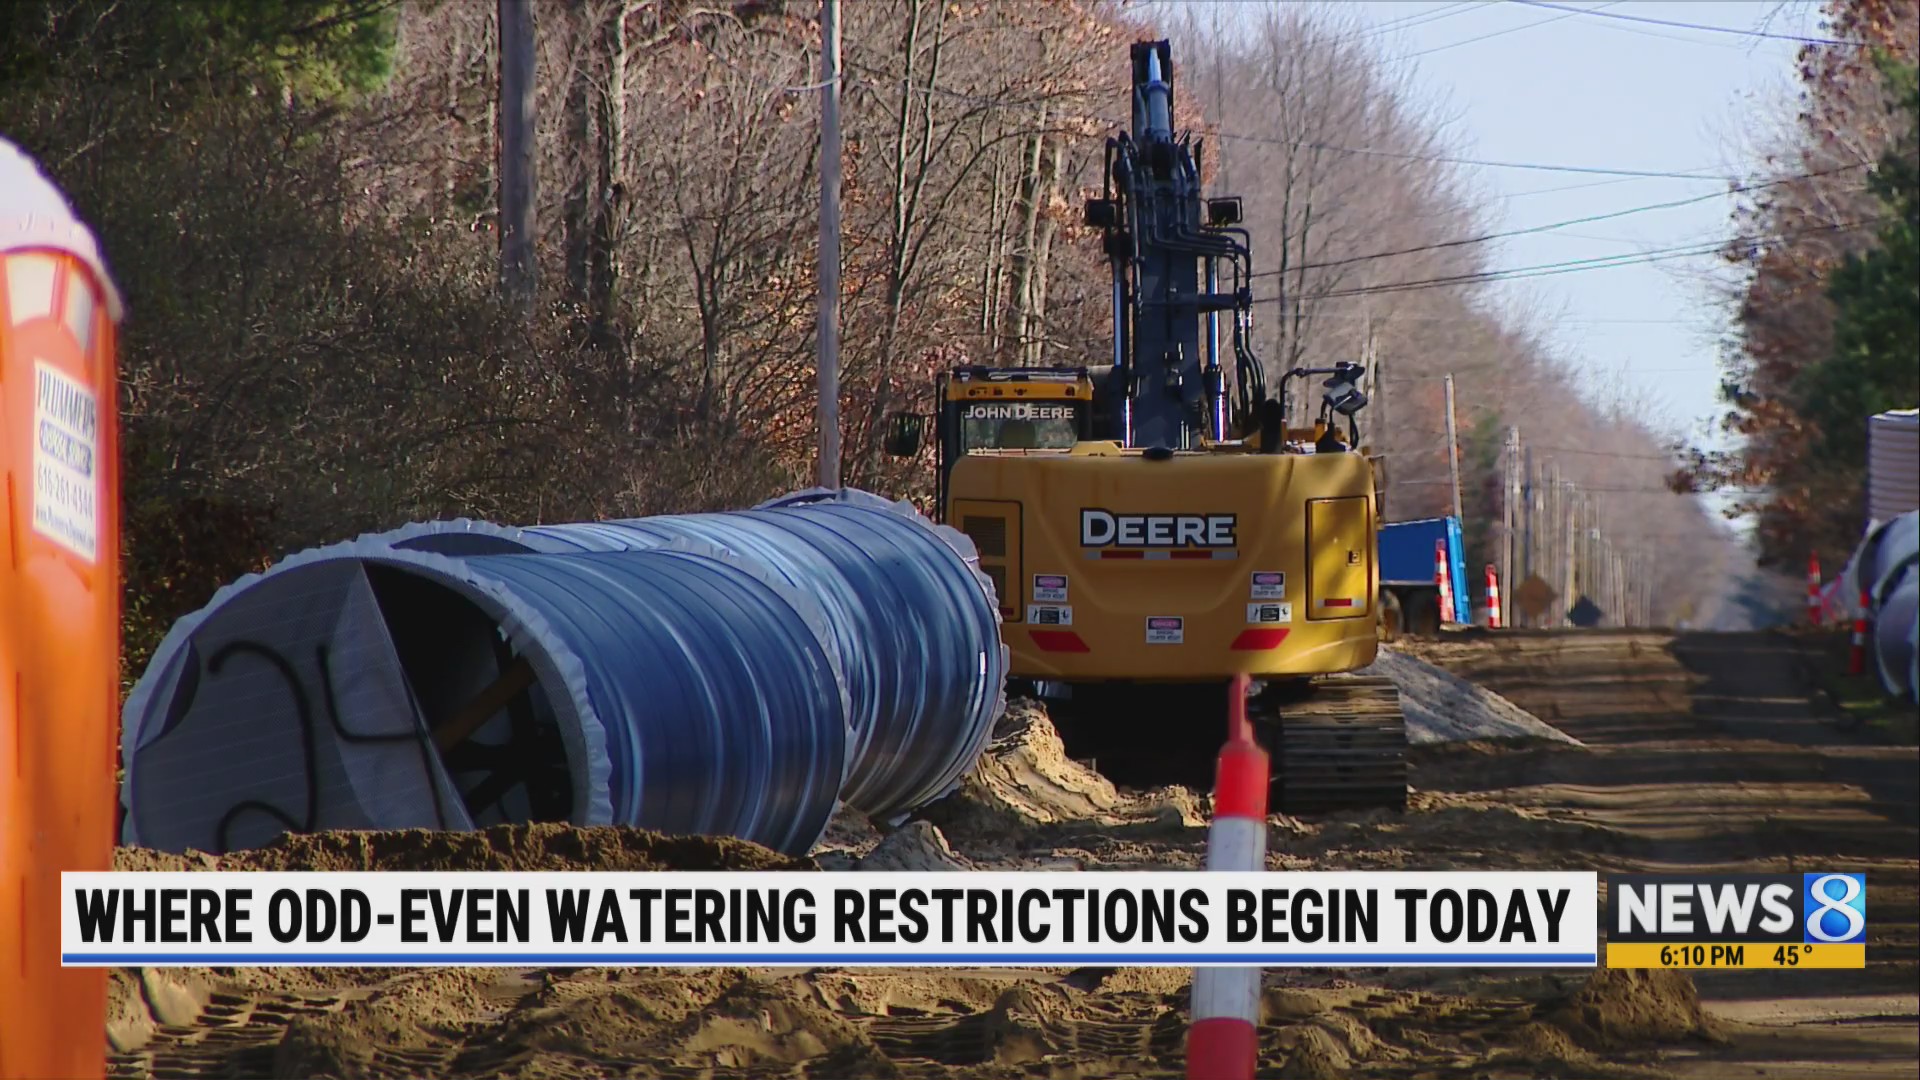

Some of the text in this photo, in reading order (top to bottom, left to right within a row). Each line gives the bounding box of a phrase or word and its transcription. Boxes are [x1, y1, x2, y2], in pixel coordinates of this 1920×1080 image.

[965, 404, 1075, 419] JOHN DEERE
[1082, 510, 1235, 546] DEERE
